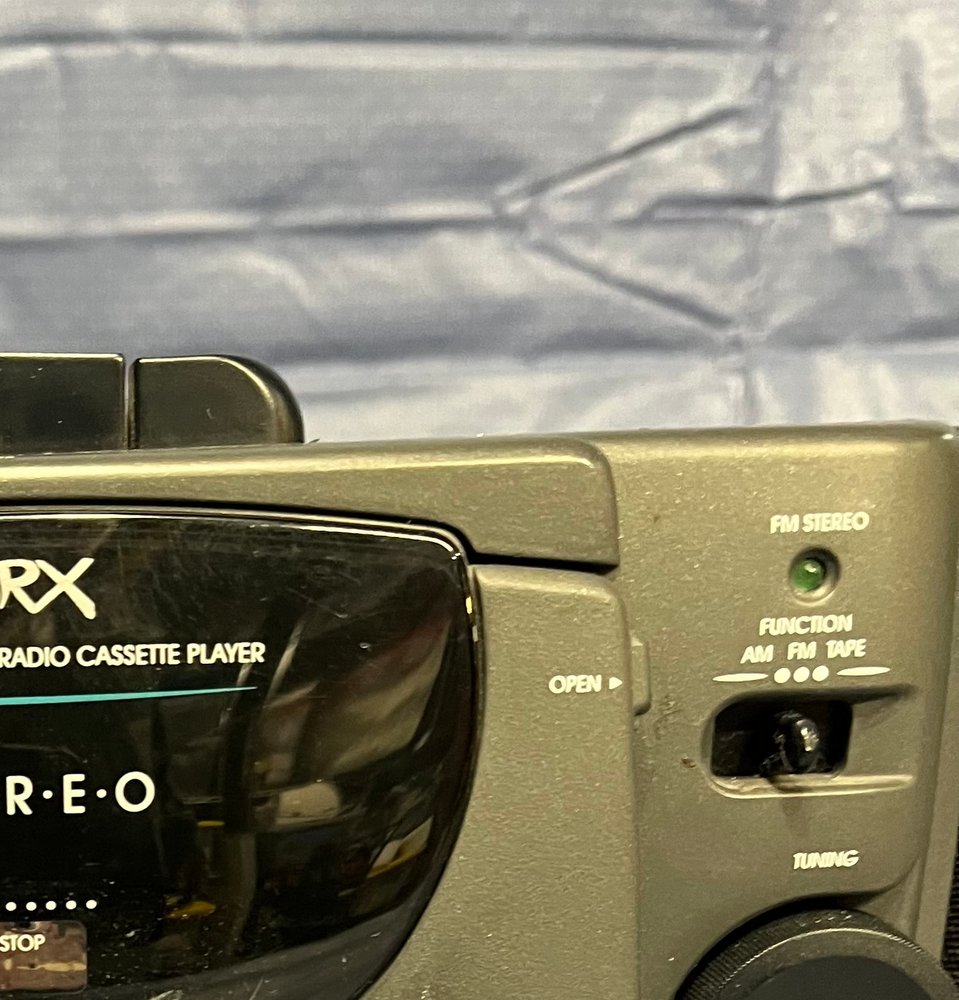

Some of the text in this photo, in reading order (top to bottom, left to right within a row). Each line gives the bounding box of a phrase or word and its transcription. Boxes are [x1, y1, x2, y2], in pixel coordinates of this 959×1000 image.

[771, 506, 872, 533] FM STEREO
[759, 614, 852, 635] FUNCTION
[76, 643, 180, 666] CASSETTE
[187, 642, 265, 664] PLAYER
[740, 639, 866, 663] AM FM TAPE
[549, 675, 602, 693] OPEN
[794, 850, 859, 869] TUNING
[0, 934, 45, 952] STOP
